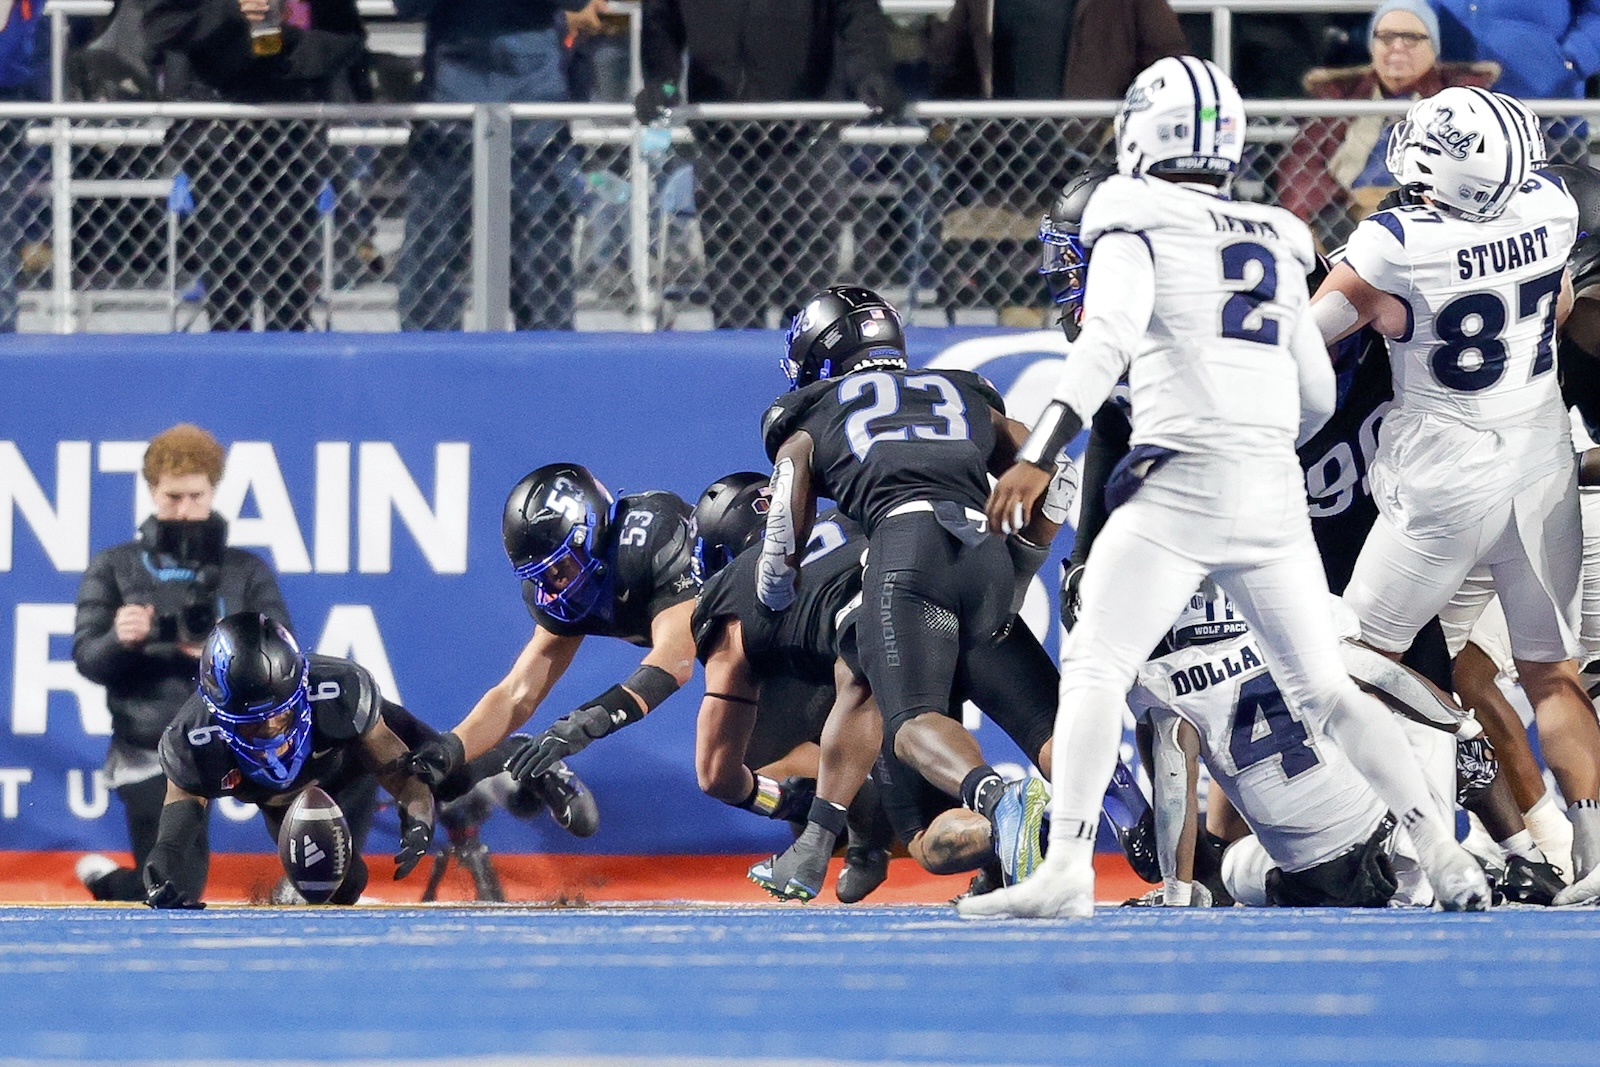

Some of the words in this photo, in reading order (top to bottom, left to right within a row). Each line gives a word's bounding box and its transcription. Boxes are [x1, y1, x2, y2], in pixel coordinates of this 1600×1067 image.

[1218, 240, 1280, 347] 2
[1456, 225, 1549, 281] STUART
[1427, 264, 1566, 394] 87
[837, 371, 971, 463] 23
[619, 510, 654, 547] 53
[880, 571, 901, 668] BRONCOS
[1194, 625, 1221, 636] WOLF
[1223, 622, 1248, 634] PACK
[306, 681, 341, 702] 6
[1227, 673, 1326, 784] 4
